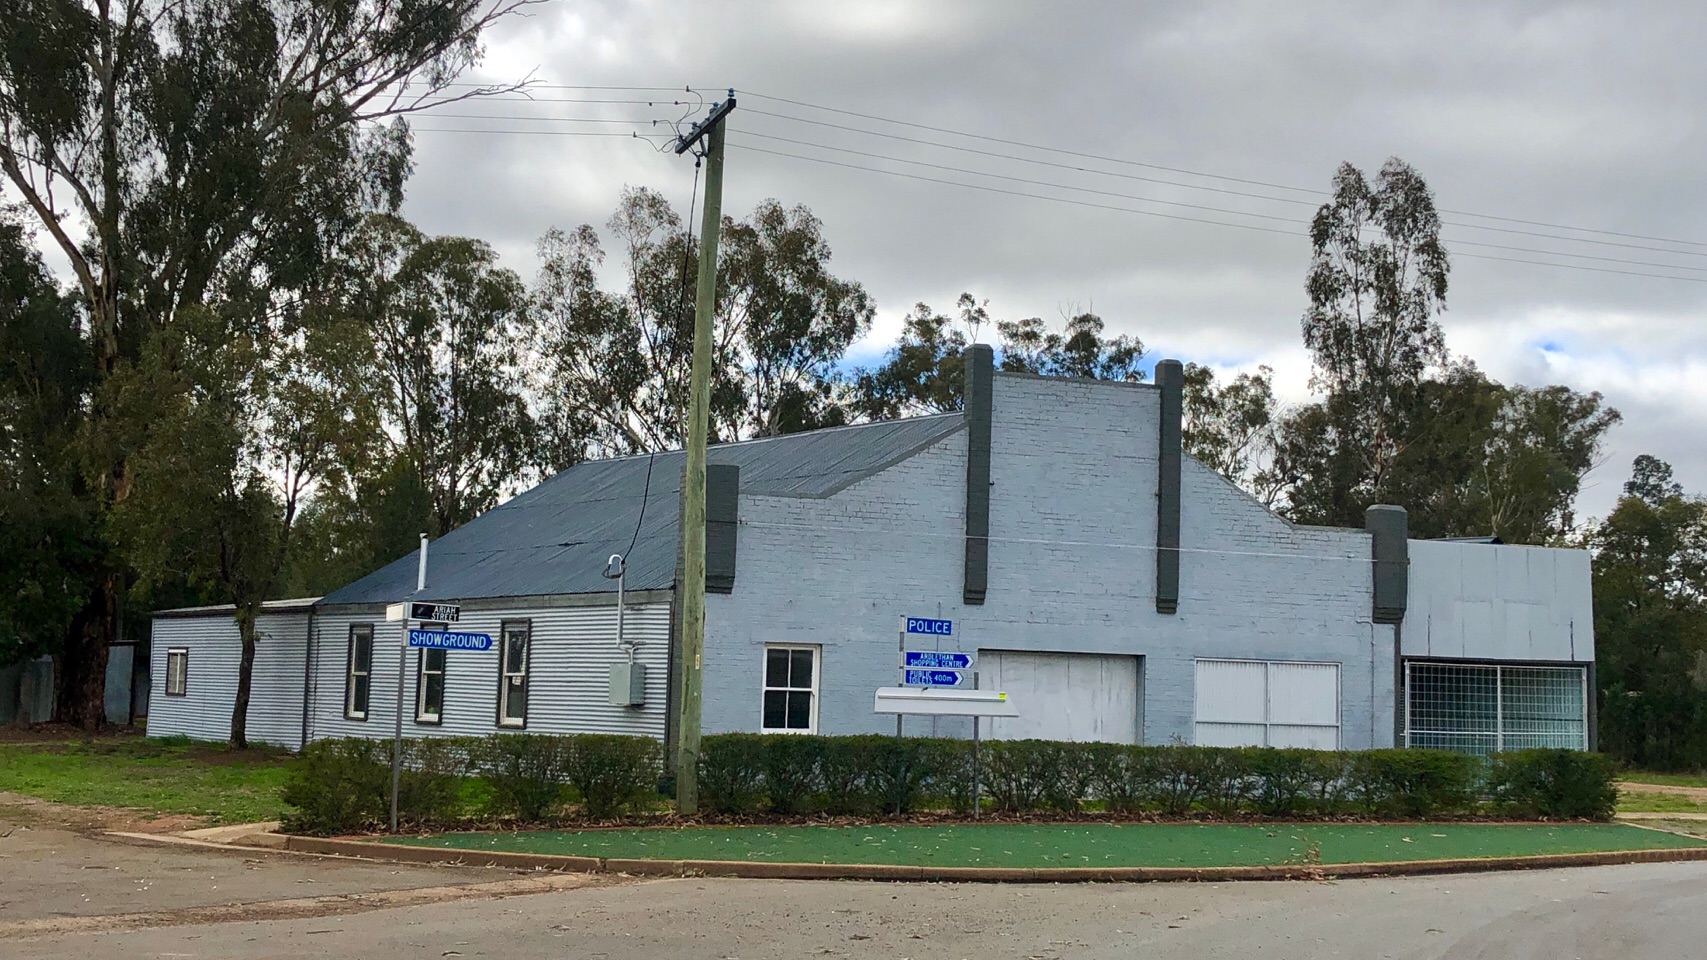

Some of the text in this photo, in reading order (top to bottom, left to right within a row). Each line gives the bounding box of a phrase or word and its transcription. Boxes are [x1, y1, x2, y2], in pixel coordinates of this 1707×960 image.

[433, 605, 456, 614] ARIAH
[431, 612, 458, 622] STREET
[909, 620, 950, 634] POLICE
[411, 631, 487, 648] SHOWGROUND
[910, 659, 964, 668] SHOPPING CENTRE
[909, 676, 933, 684] TOILETS
[934, 674, 953, 682] 400m
